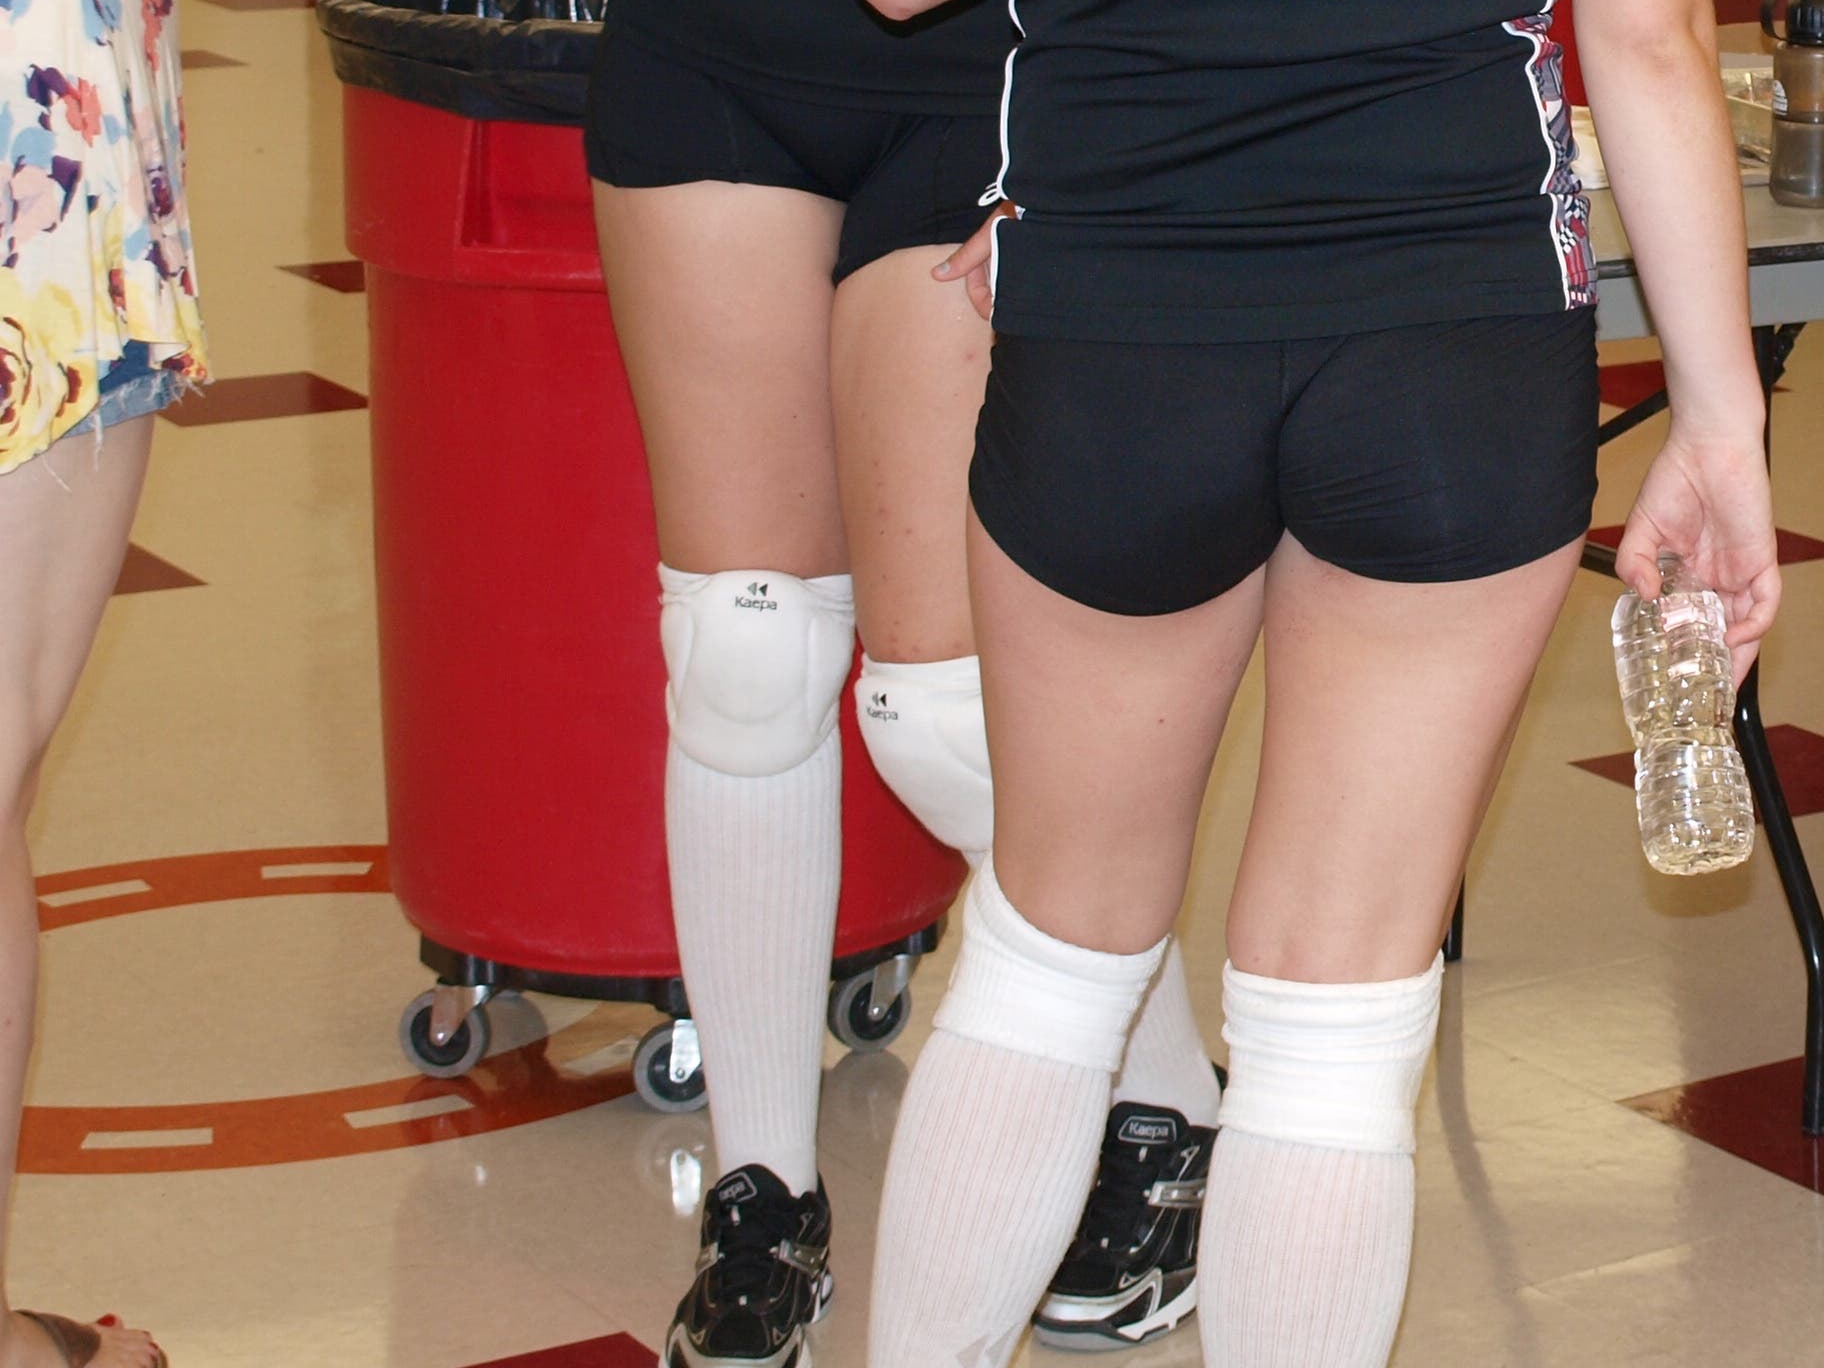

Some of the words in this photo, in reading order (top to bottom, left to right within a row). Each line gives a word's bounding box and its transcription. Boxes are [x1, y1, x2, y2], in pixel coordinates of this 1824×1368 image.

[735, 596, 778, 612] Kaepa
[1128, 1121, 1169, 1141] Kaepa
[718, 1181, 746, 1201] aepa
